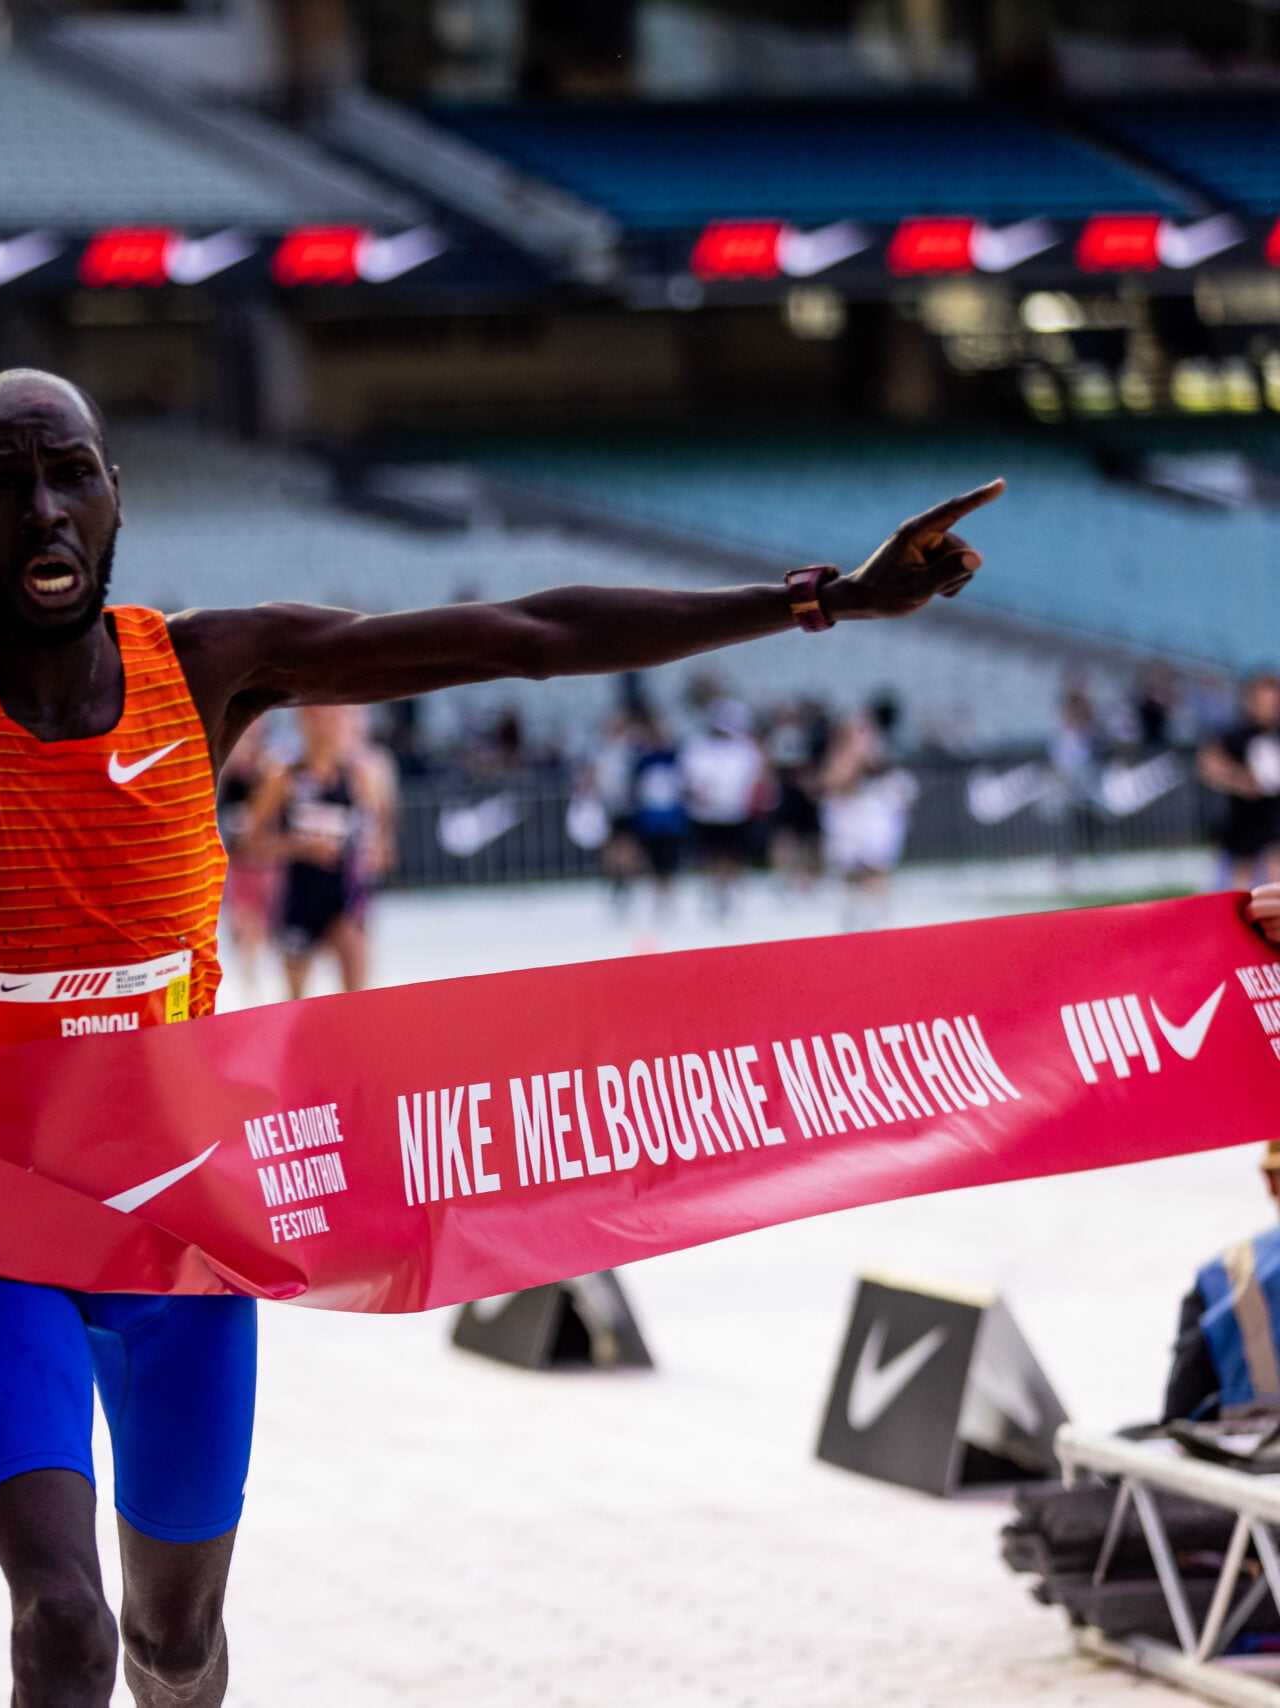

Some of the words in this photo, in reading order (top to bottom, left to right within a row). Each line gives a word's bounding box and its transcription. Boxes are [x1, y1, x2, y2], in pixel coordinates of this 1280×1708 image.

[244, 1103, 344, 1160] MELBOURNE
[397, 1082, 501, 1206] NIKE
[509, 1045, 783, 1187] MELBOURNE
[772, 1014, 1022, 1140] MARATHON
[257, 1152, 348, 1207] MARATHON
[270, 1206, 330, 1243] FESTIVAL
